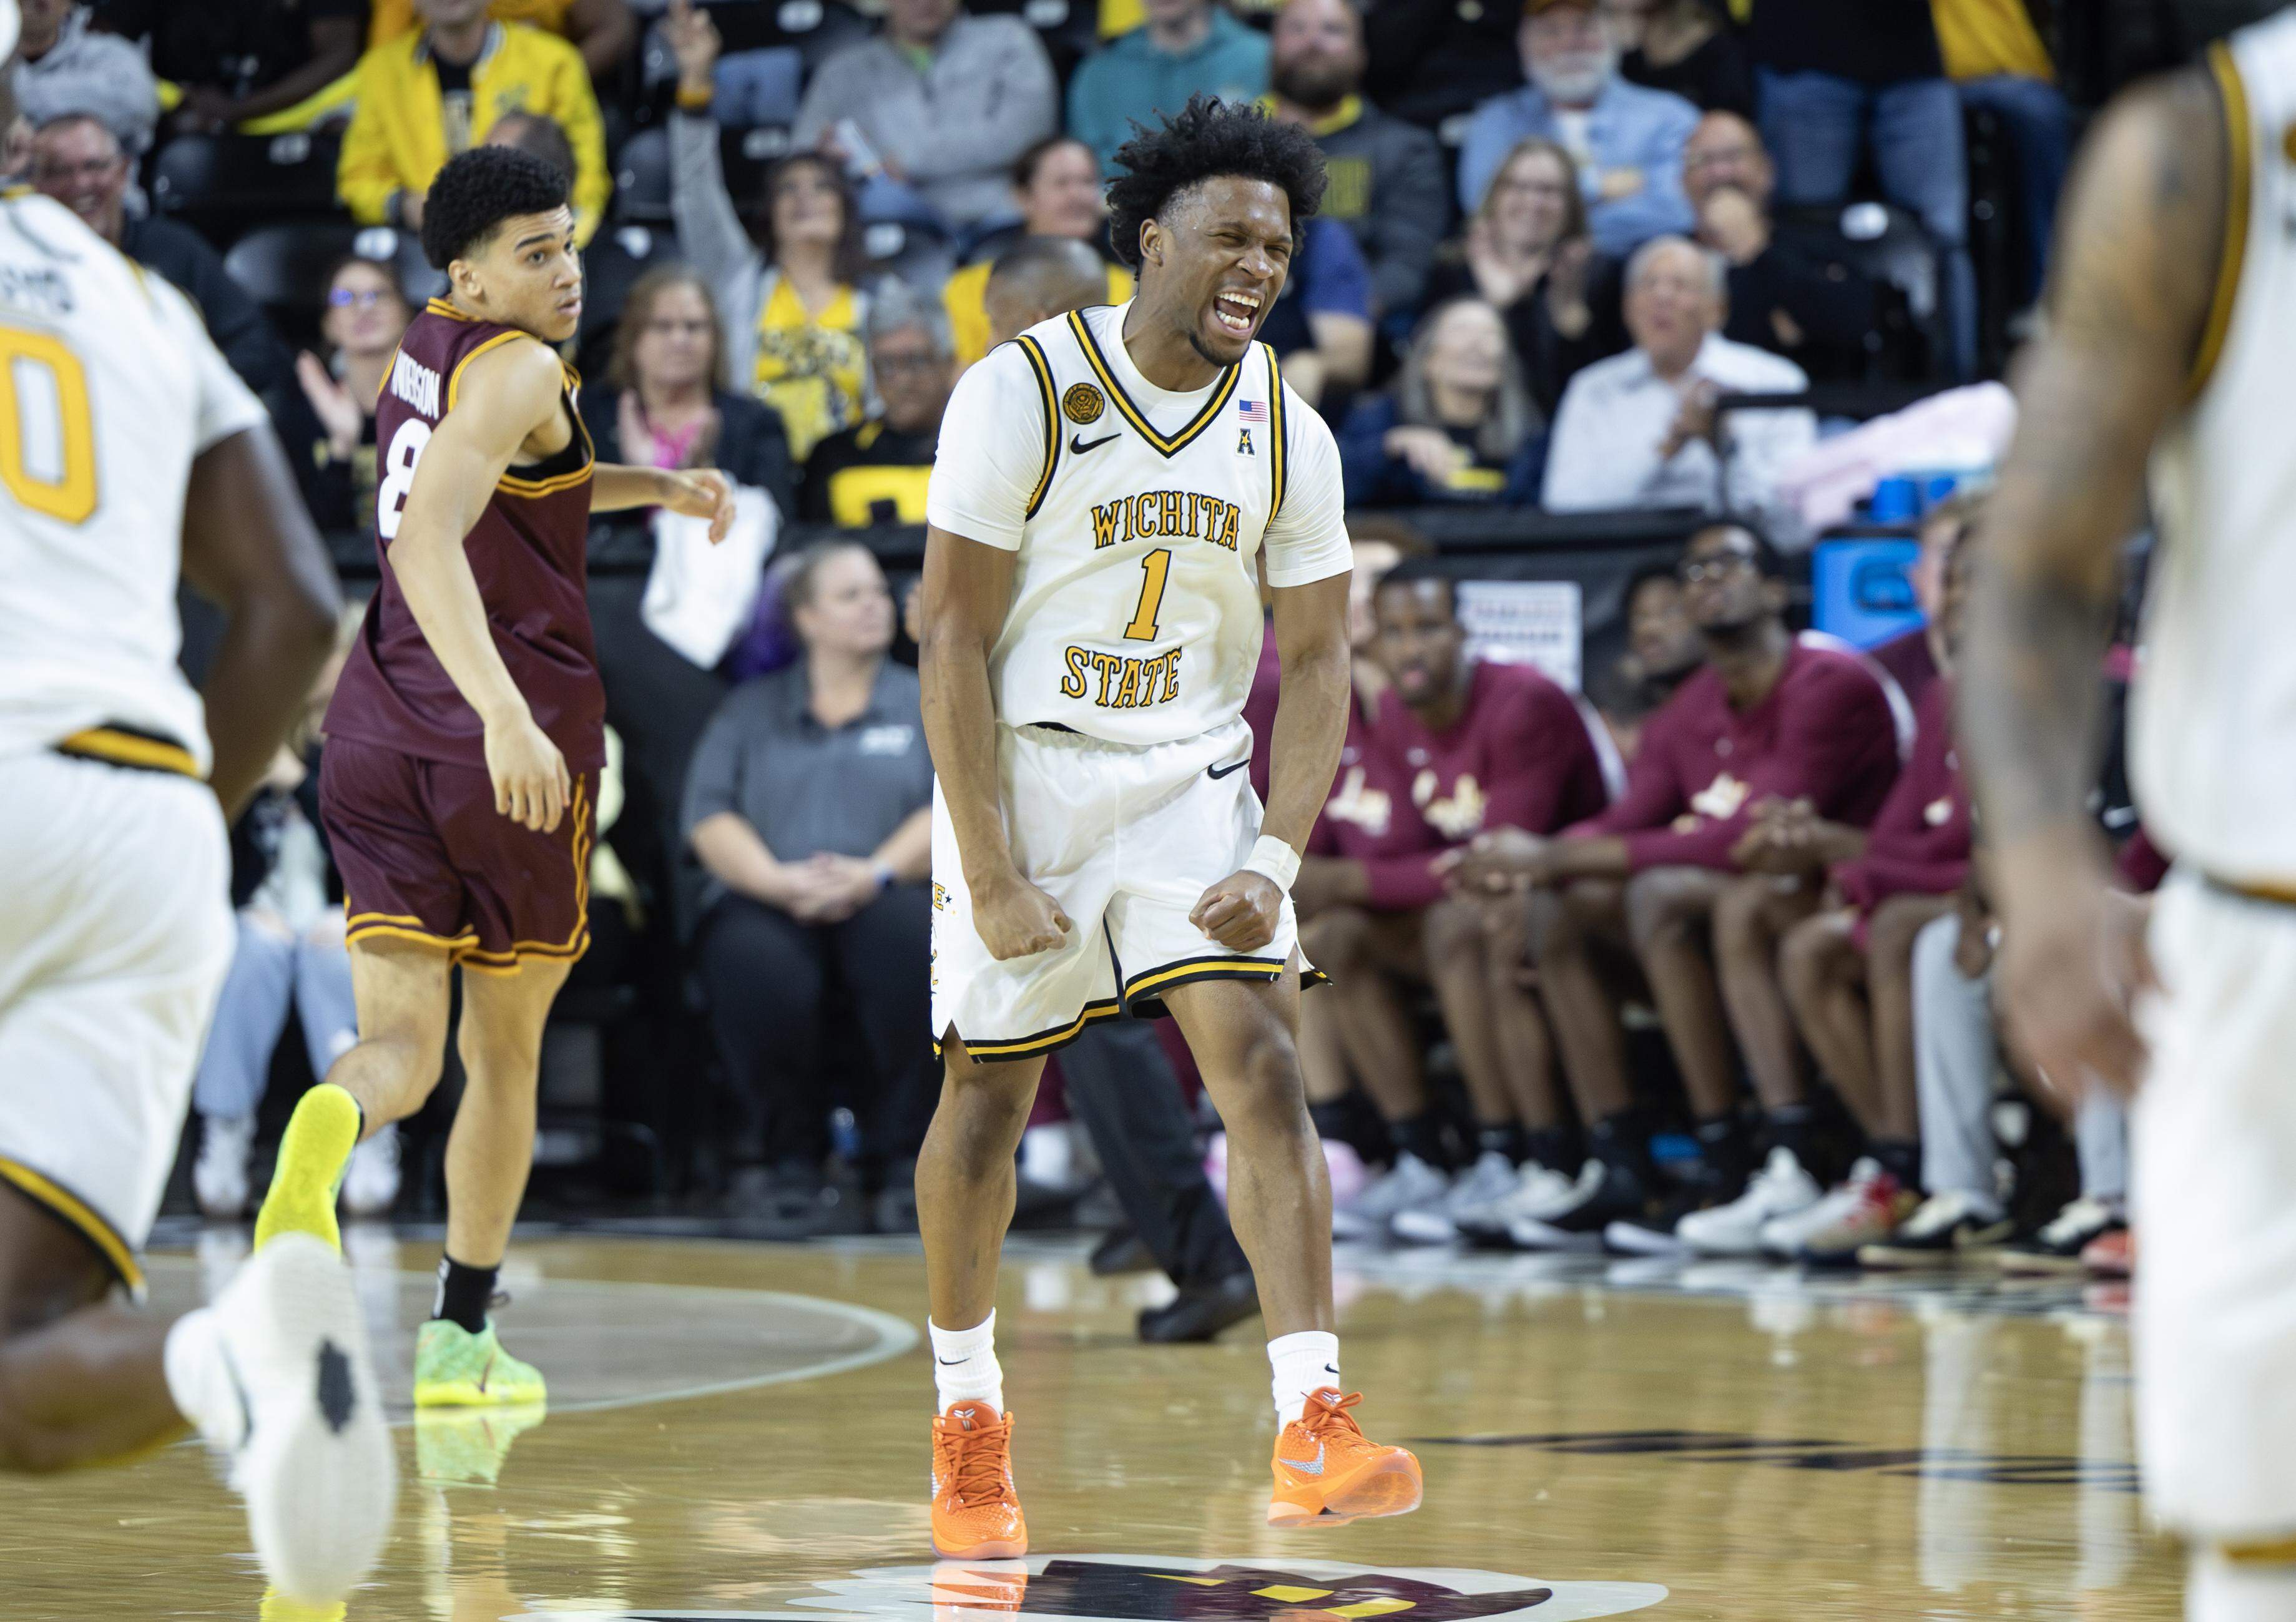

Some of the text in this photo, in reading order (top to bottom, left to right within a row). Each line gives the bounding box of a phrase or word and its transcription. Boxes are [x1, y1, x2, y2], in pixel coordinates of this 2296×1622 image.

[390, 348, 440, 420] NDERSON
[378, 417, 432, 539] 8
[1091, 490, 1240, 551] WICHITA
[1123, 548, 1172, 642] 1
[1060, 646, 1182, 709] STATE
